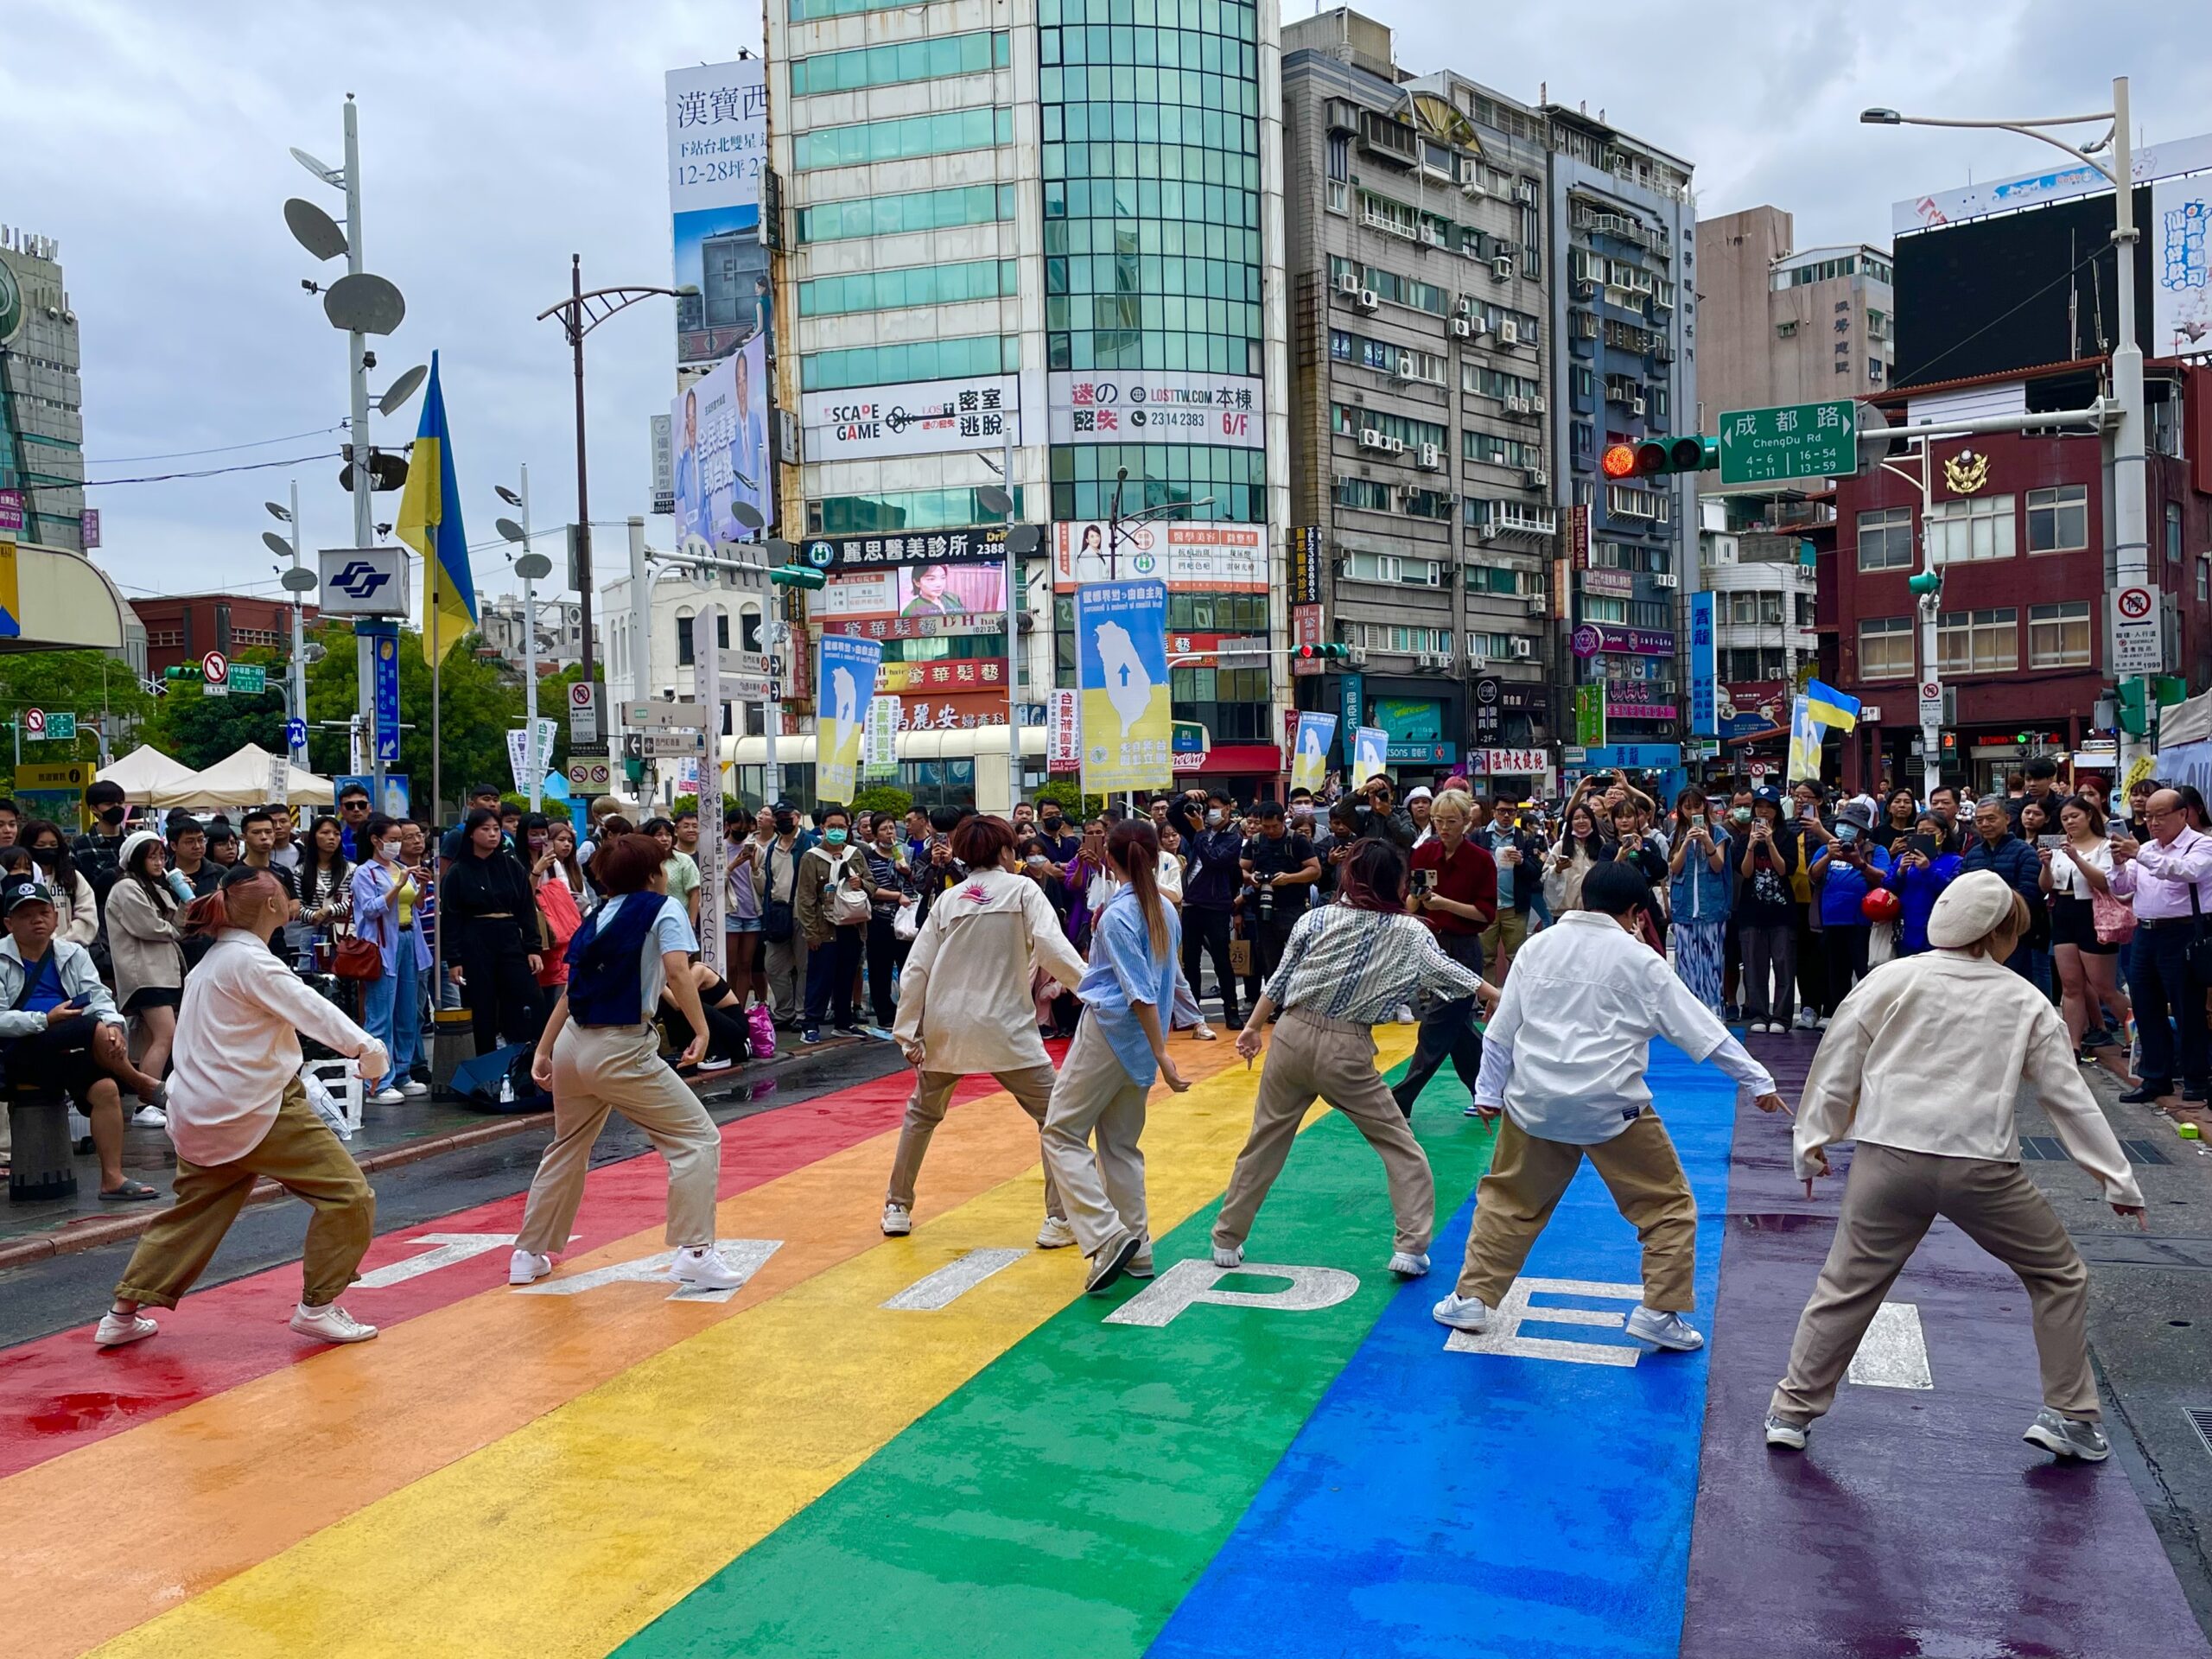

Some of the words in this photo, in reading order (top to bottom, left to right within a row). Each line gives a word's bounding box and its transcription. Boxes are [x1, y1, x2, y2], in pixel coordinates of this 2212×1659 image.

[679, 159, 745, 186] 12-28坪
[959, 388, 1001, 412] 密室
[1151, 388, 1212, 404] LOSTTW.COM
[1216, 386, 1253, 410] 本棟
[960, 415, 1002, 437] 逃脫
[1151, 412, 1178, 426] 2314
[1179, 413, 1205, 427] 2383
[1223, 411, 1249, 436] 6/F
[1735, 406, 1840, 436] 成都路
[836, 423, 880, 442] GAME
[1752, 436, 1801, 449] ChengDu
[842, 534, 969, 563] 麗思醫美診所
[1694, 607, 1710, 646] 青龍
[1617, 747, 1639, 766] 青龍
[1231, 953, 1243, 963] 25
